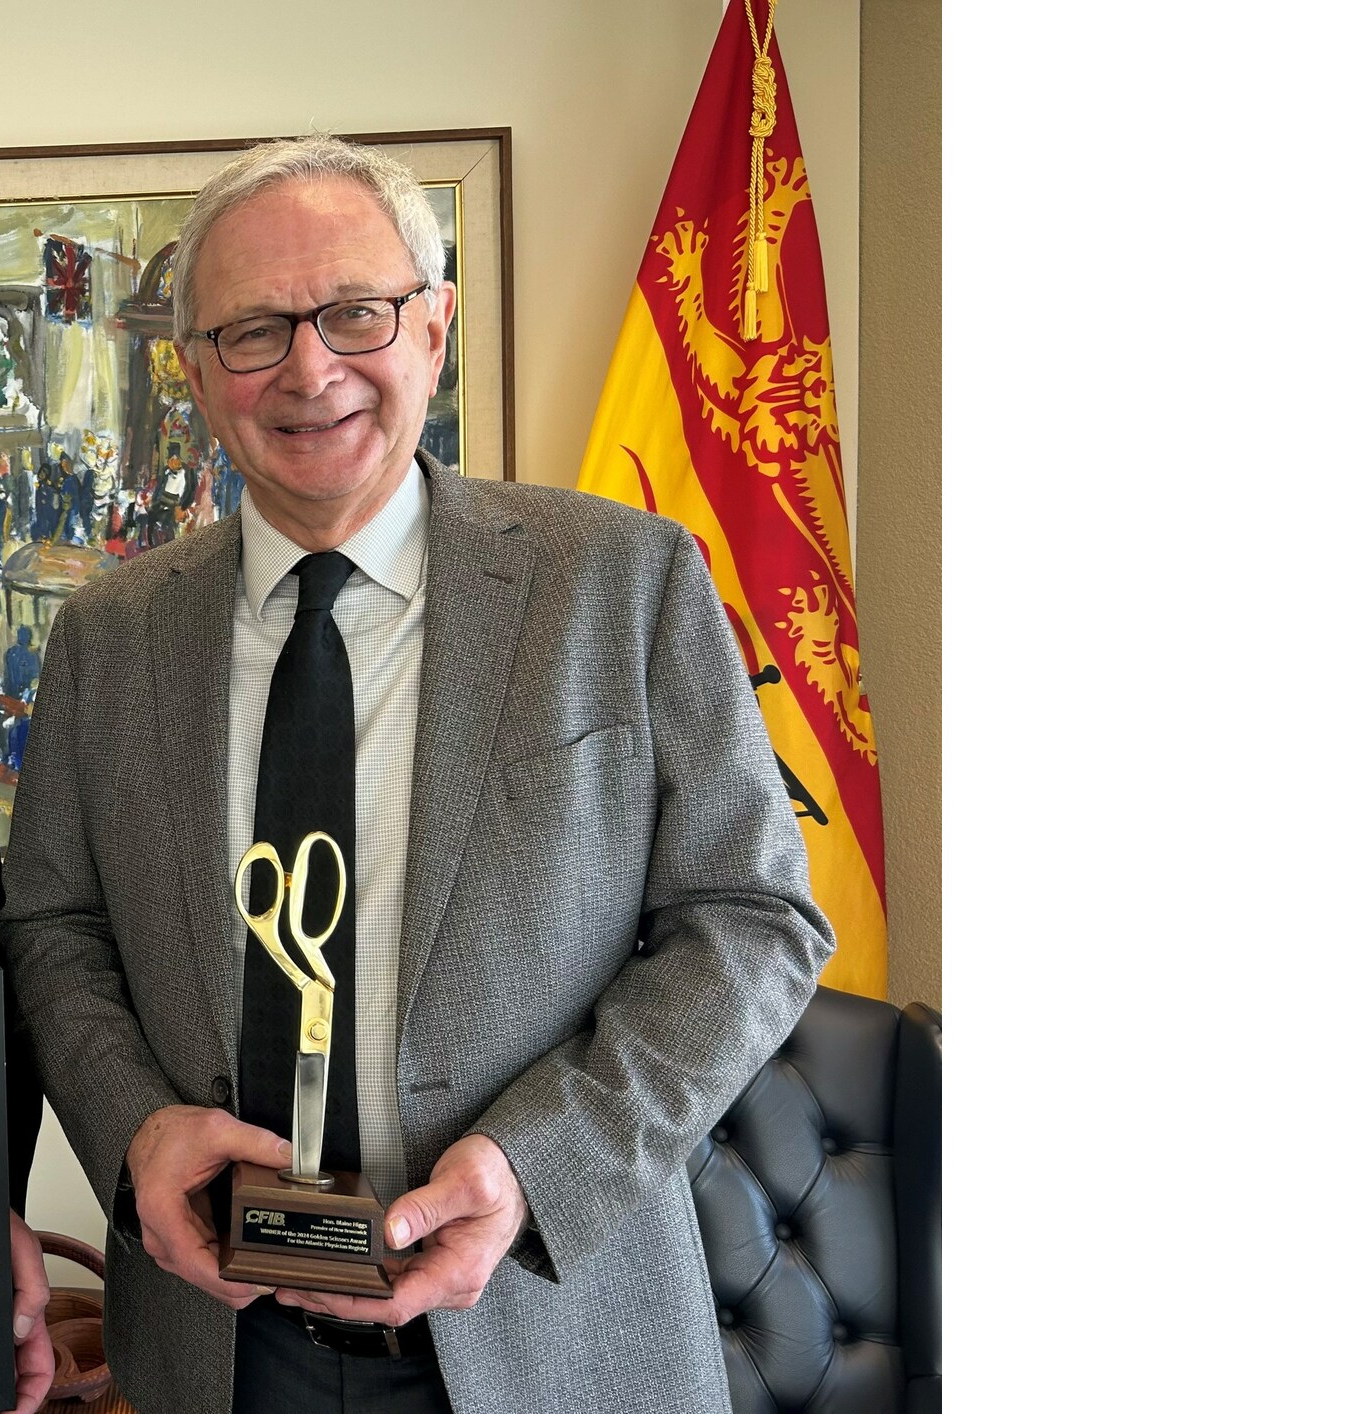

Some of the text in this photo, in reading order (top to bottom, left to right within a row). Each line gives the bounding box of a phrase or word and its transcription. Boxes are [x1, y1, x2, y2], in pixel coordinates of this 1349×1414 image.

[245, 1210, 286, 1226] CFIB
[336, 1219, 352, 1227] Blaine
[352, 1221, 368, 1230] Higgs
[310, 1233, 328, 1241] Golden
[324, 1242, 348, 1250] Physician
[348, 1244, 368, 1252] Registry
